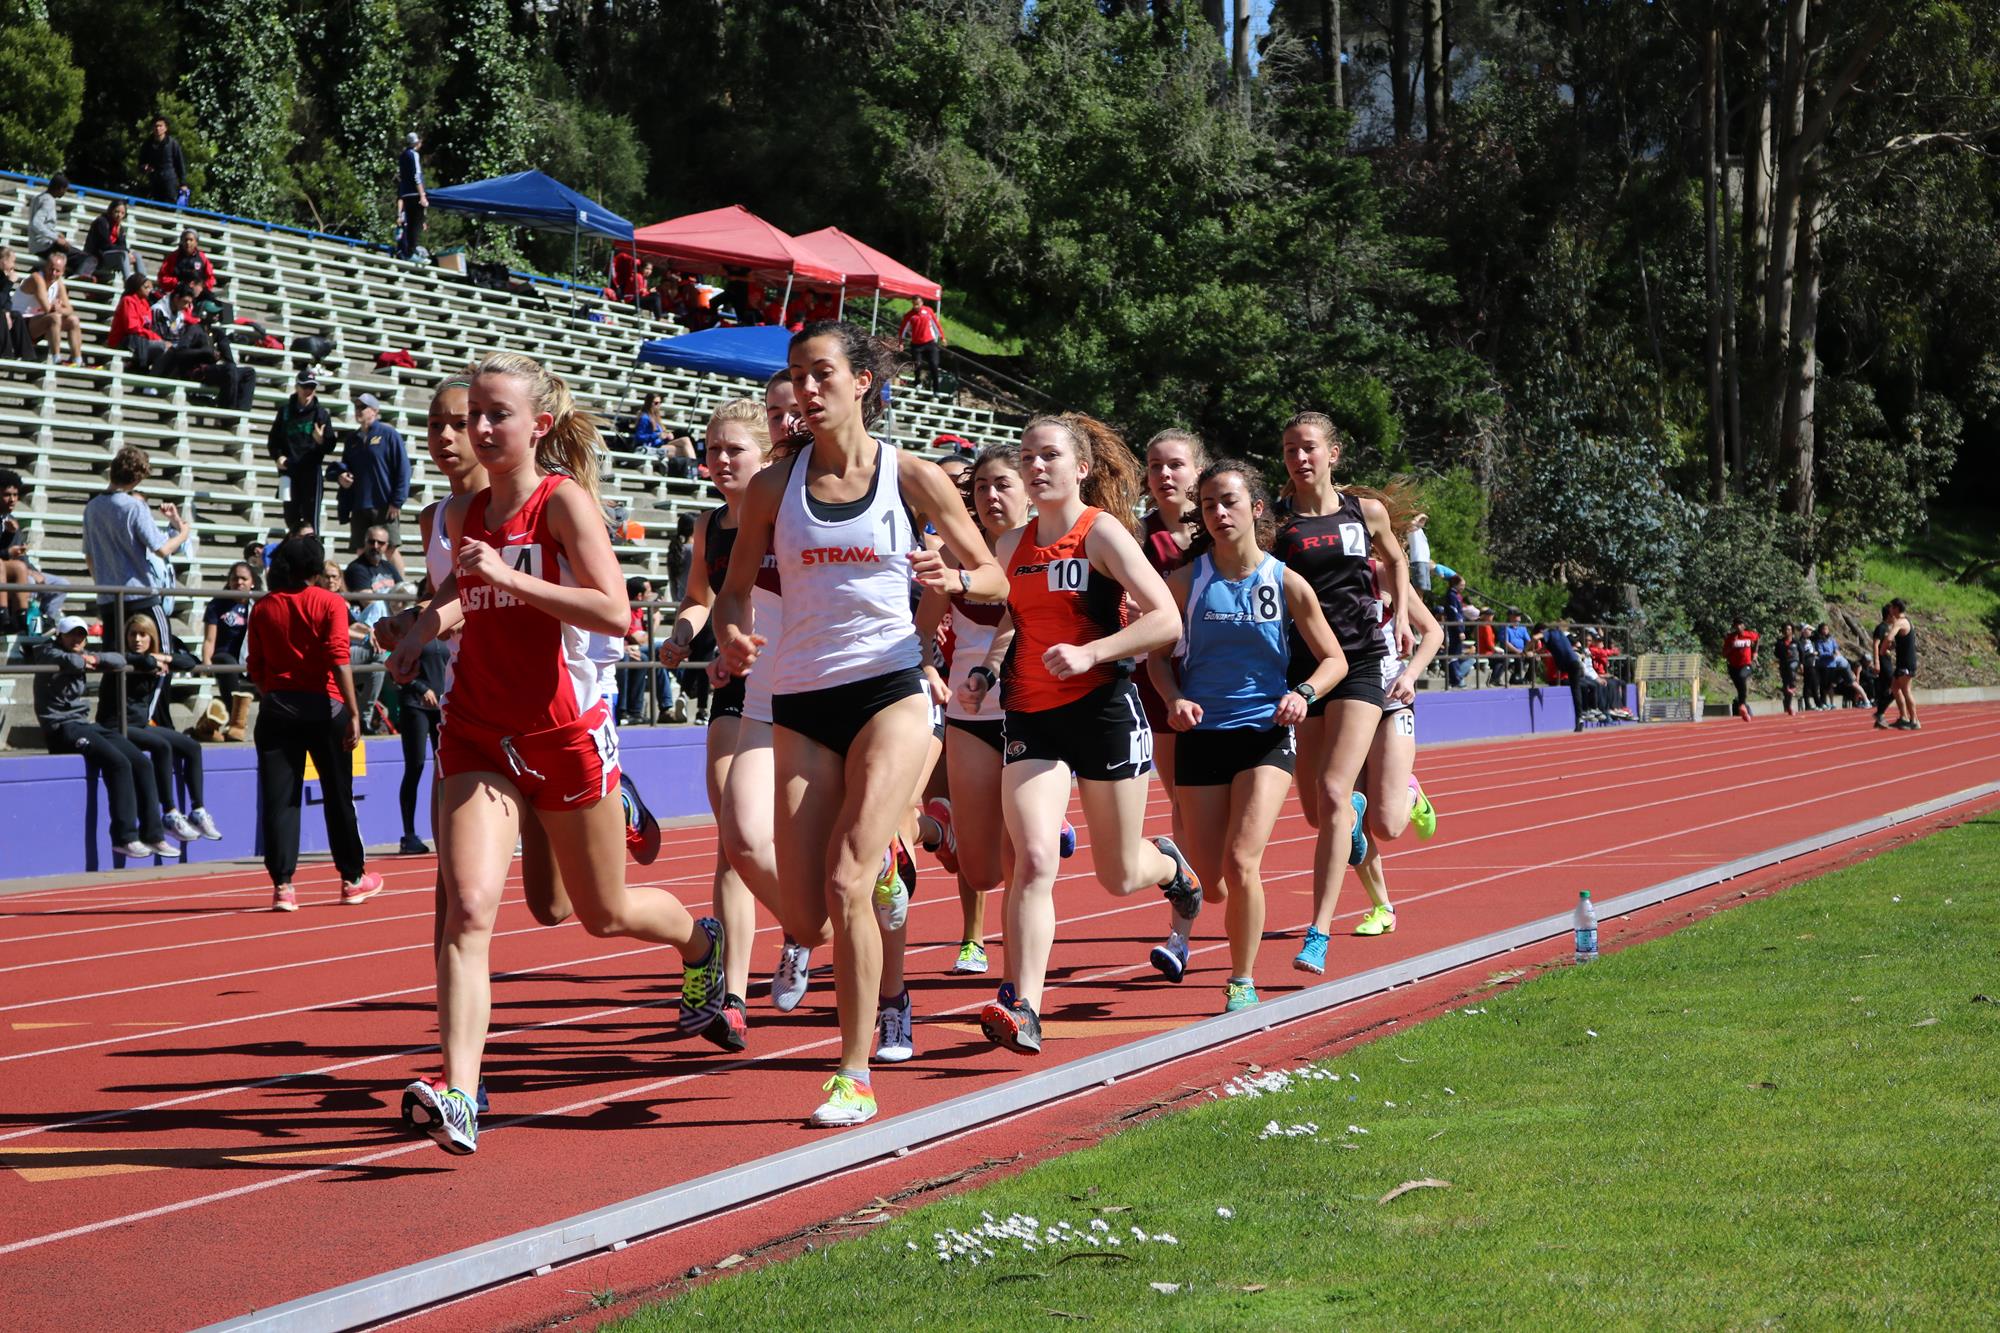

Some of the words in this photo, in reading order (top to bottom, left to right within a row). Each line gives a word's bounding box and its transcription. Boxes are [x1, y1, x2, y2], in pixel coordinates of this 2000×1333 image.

[880, 509, 896, 552] 1
[1345, 524, 1363, 554] 2
[801, 546, 880, 566] STRAVA
[1014, 563, 1050, 577] PACIF
[1054, 559, 1082, 589] 10
[460, 585, 492, 612] AST
[1258, 585, 1278, 620] 8
[1400, 714, 1413, 735] 15
[1136, 730, 1150, 761] 10
